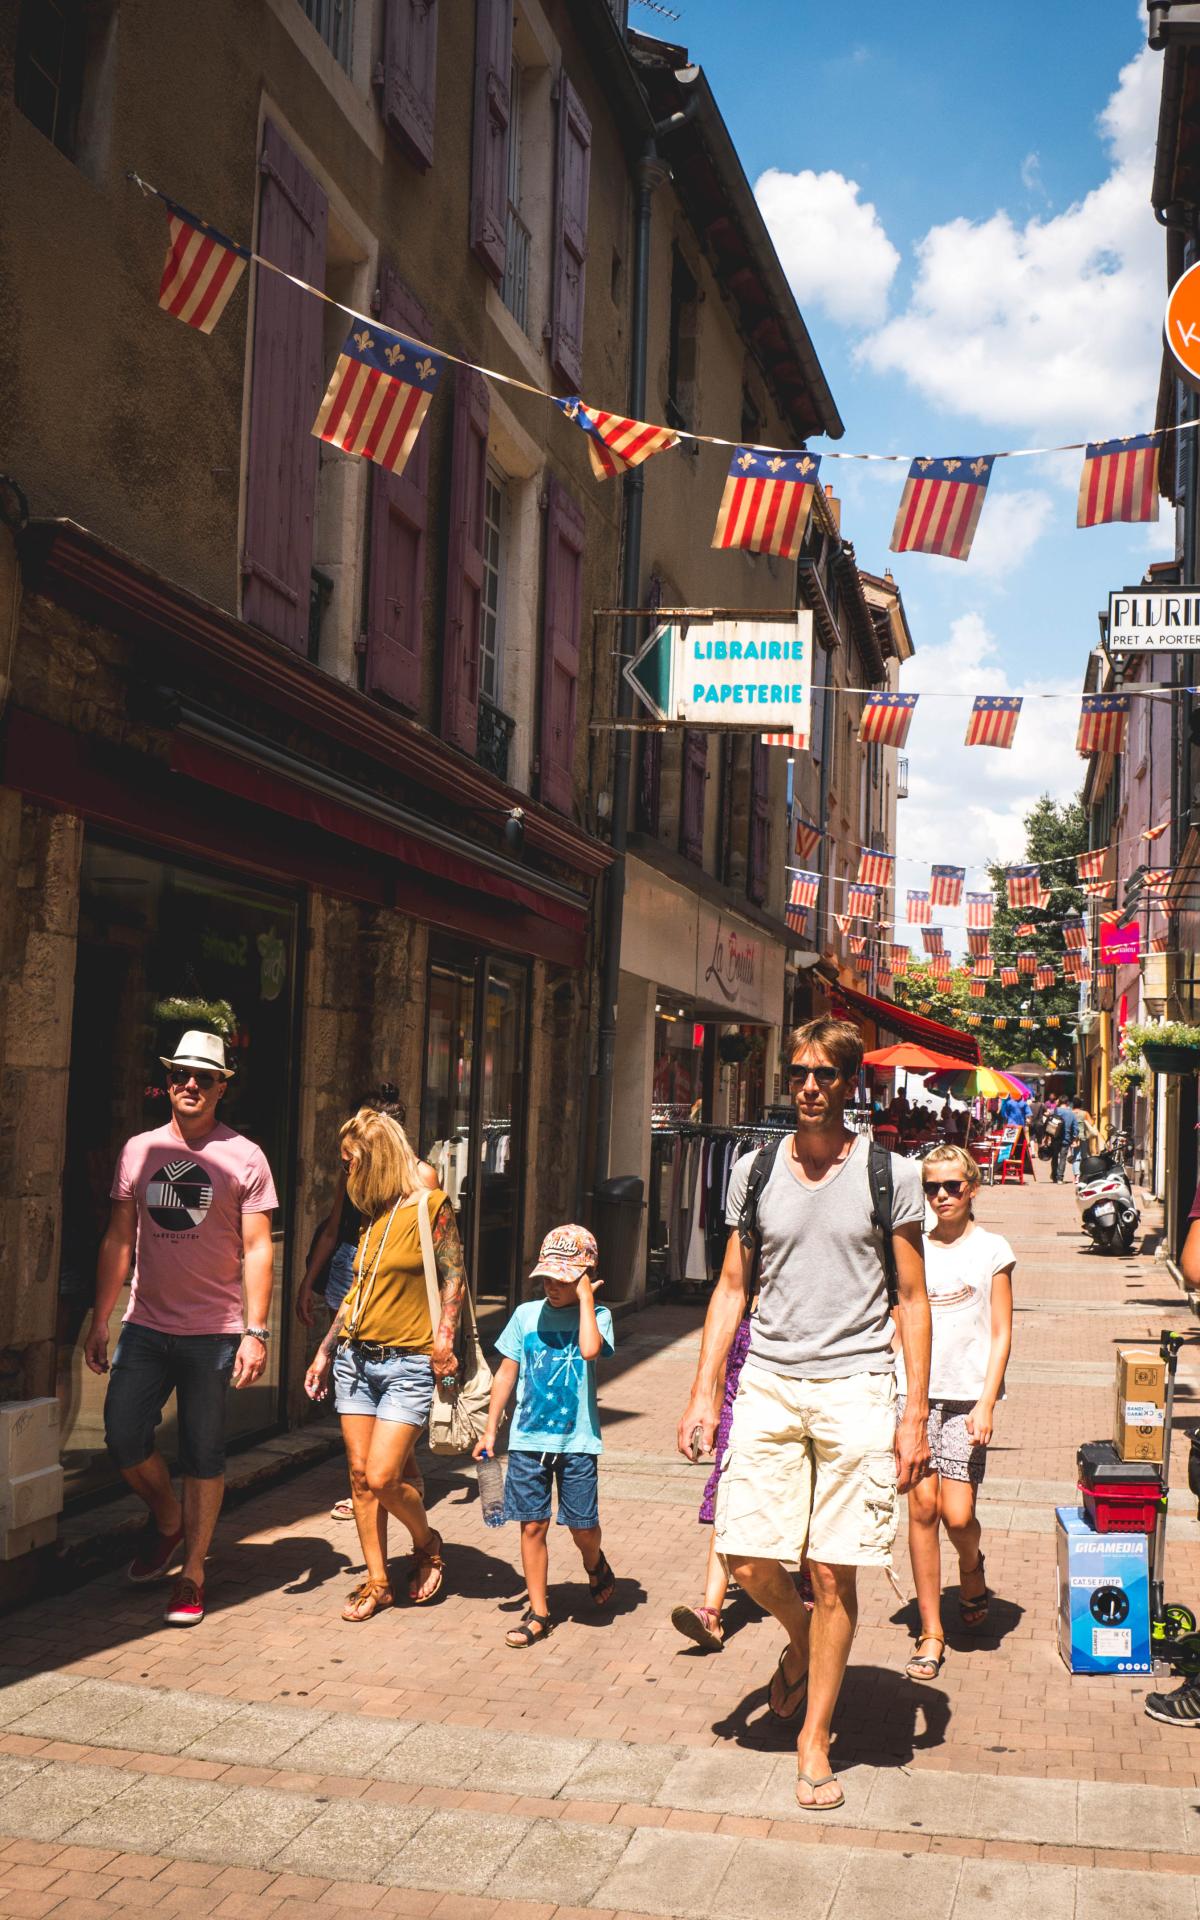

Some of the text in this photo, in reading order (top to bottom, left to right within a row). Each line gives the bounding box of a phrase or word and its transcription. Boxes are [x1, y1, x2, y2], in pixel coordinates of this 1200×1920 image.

[1114, 598, 1200, 627] PLURI
[1113, 635, 1140, 645] PRET
[1145, 635, 1154, 645] A
[694, 641, 803, 660] LIBRAIRIE
[693, 684, 802, 703] PAPETERIE
[1075, 1542, 1143, 1553] GIGAMEDIA
